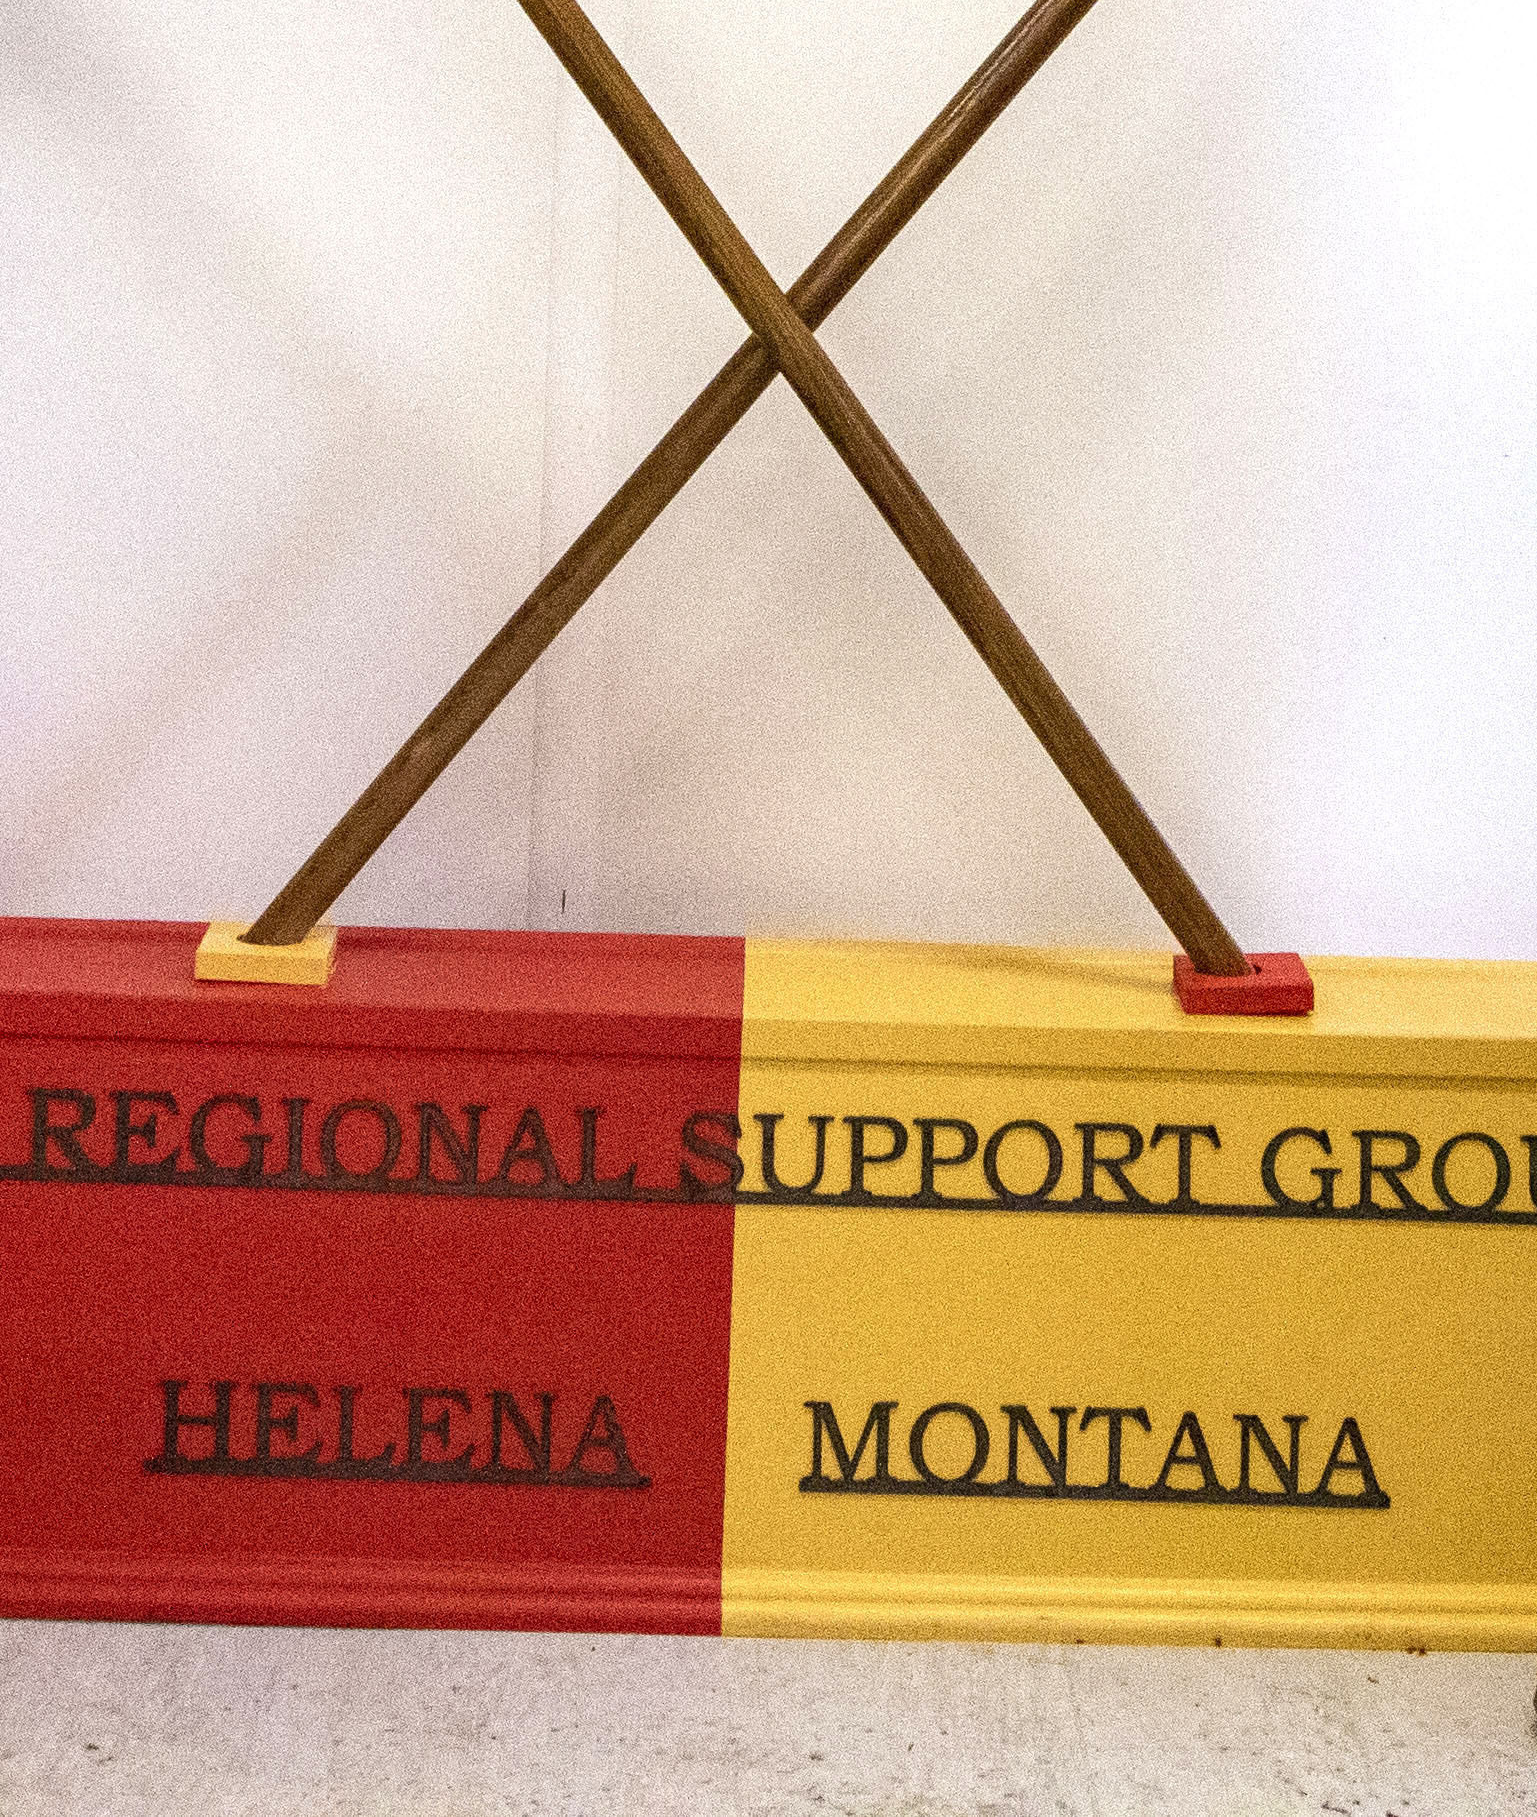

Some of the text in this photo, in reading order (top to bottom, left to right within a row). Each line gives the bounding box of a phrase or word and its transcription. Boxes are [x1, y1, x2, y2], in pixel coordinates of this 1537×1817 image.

[24, 1085, 640, 1191] REGIONAL
[675, 1105, 1224, 1209] SUPPORT
[146, 1380, 1391, 1507] HELENA MONTANA
